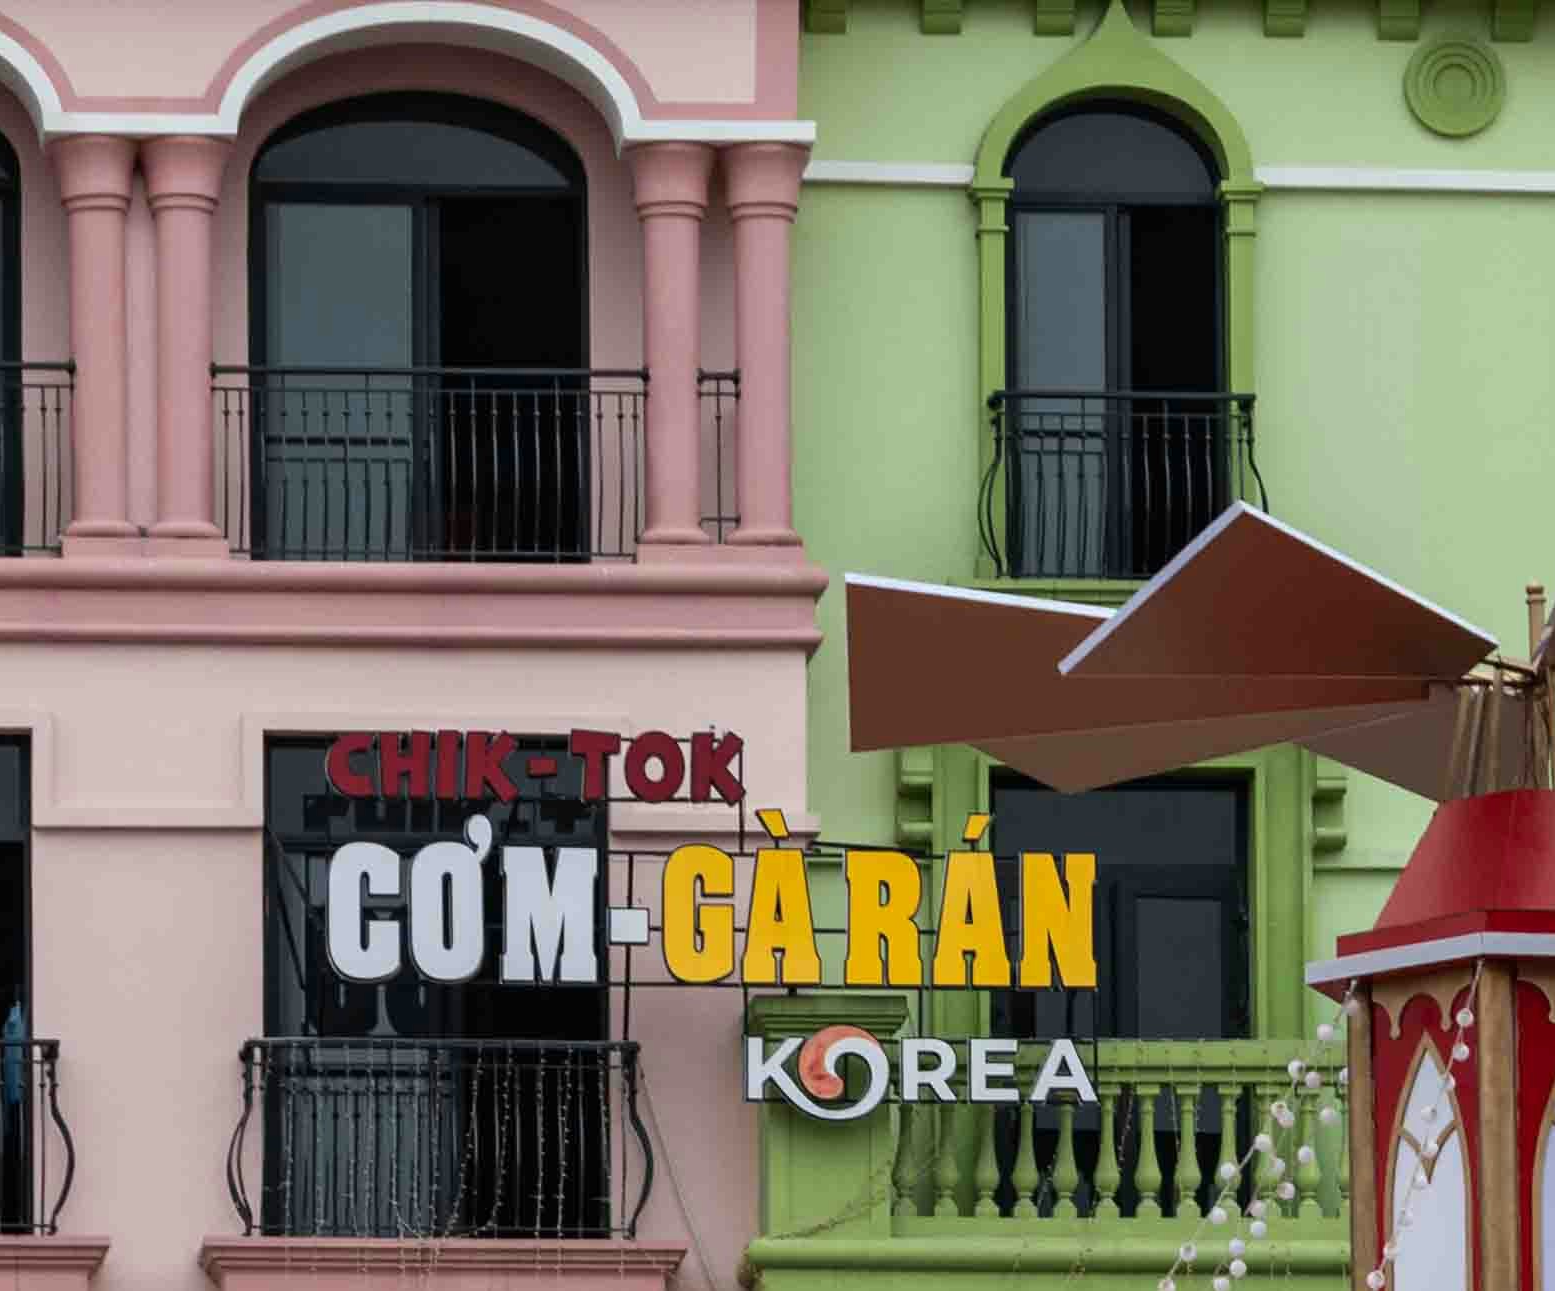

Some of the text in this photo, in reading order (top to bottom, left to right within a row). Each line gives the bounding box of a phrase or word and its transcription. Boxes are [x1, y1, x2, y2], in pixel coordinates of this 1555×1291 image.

[325, 726, 745, 804] CHIK-TOK
[844, 812, 1097, 990] RÁN
[746, 1024, 1099, 1120] KOREA
